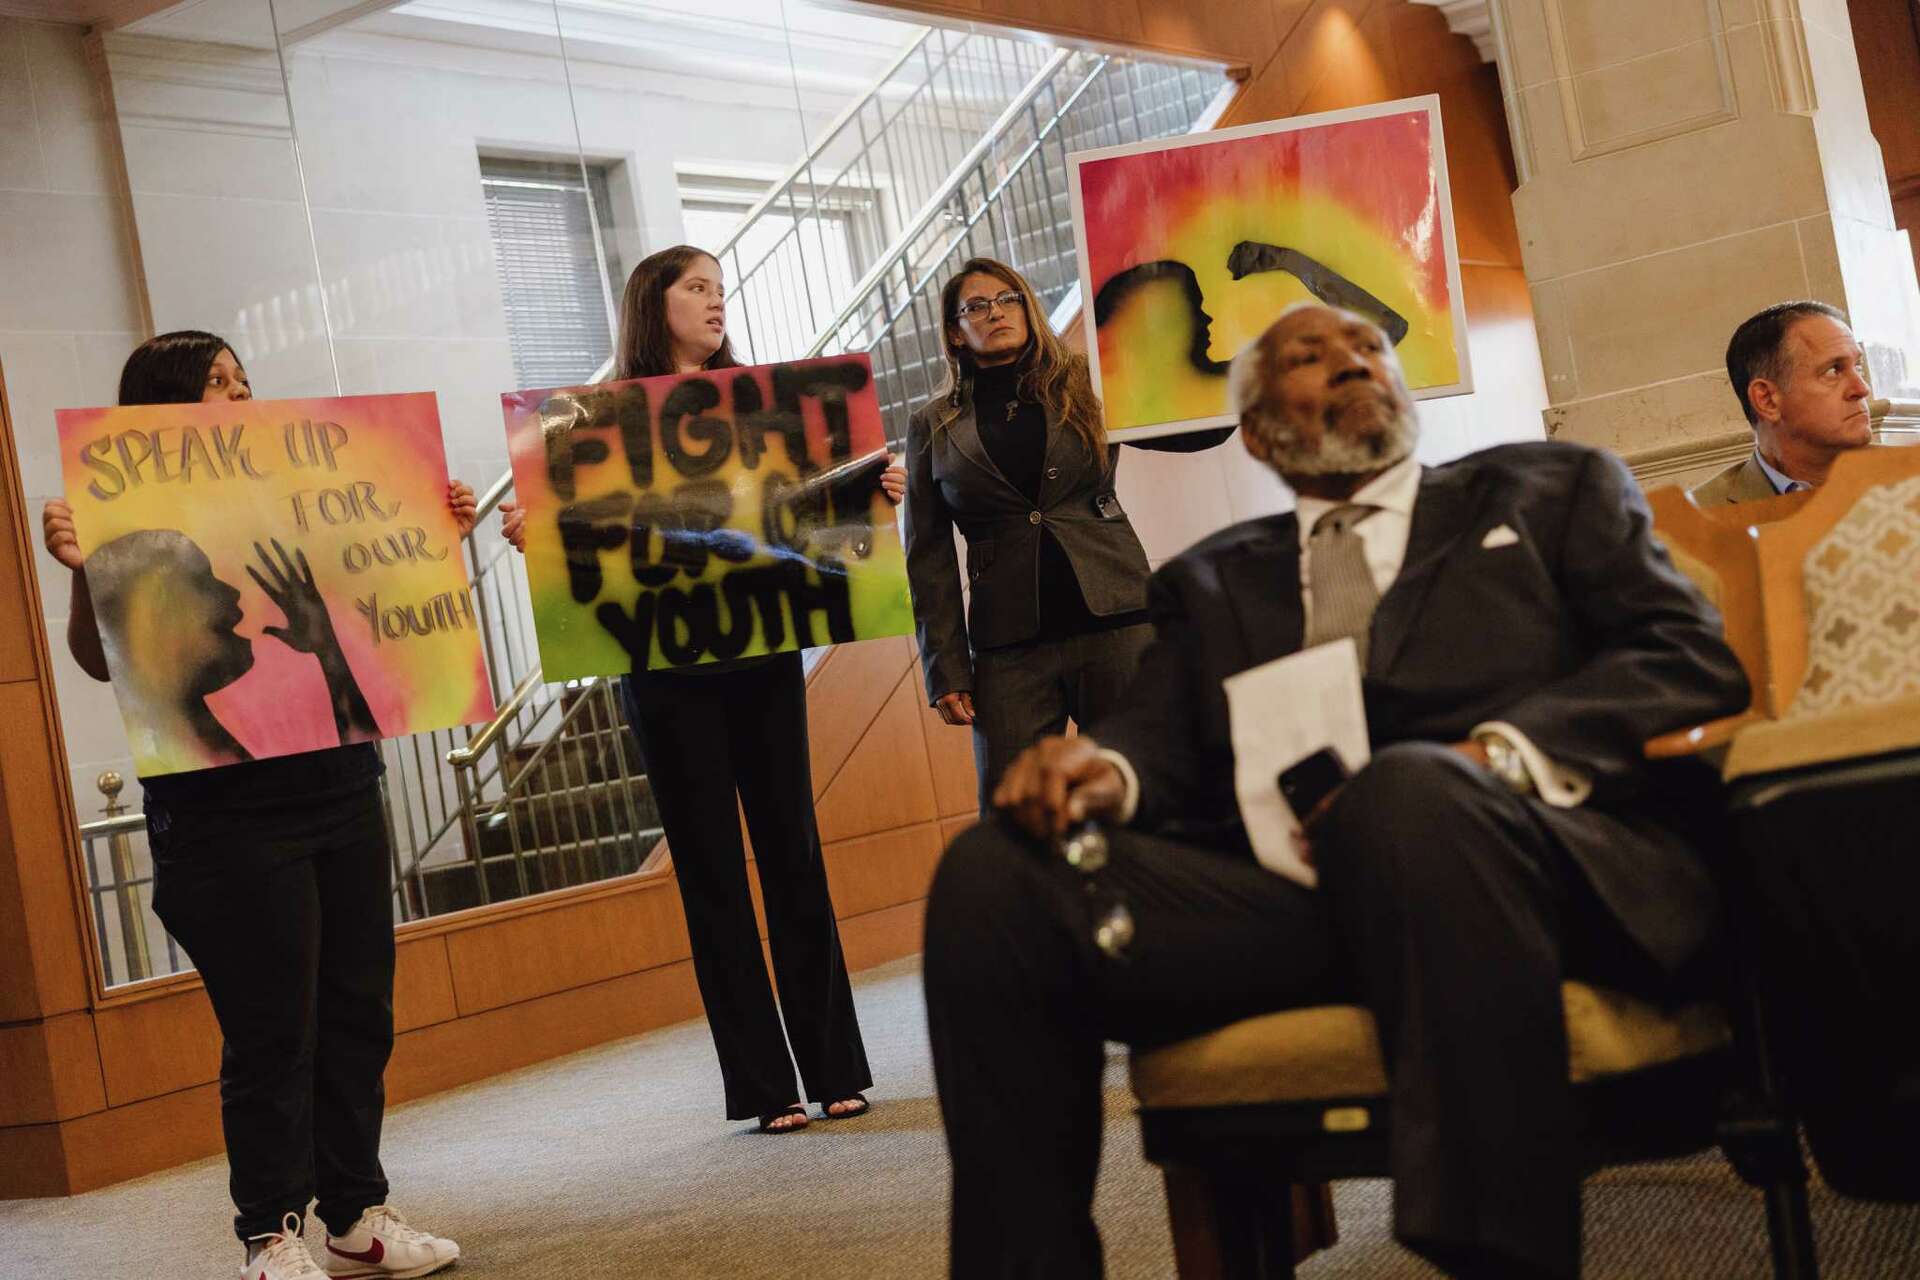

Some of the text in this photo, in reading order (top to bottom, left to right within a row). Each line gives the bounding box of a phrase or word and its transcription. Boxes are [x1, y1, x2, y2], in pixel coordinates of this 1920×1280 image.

[79, 419, 349, 500] SPEAK UP
[542, 362, 869, 500] FIGHT
[287, 481, 401, 534] FOR
[562, 479, 754, 604] FOR
[342, 527, 449, 574] OUR
[354, 586, 476, 646] YOUTH
[596, 553, 855, 673] YOUTH
